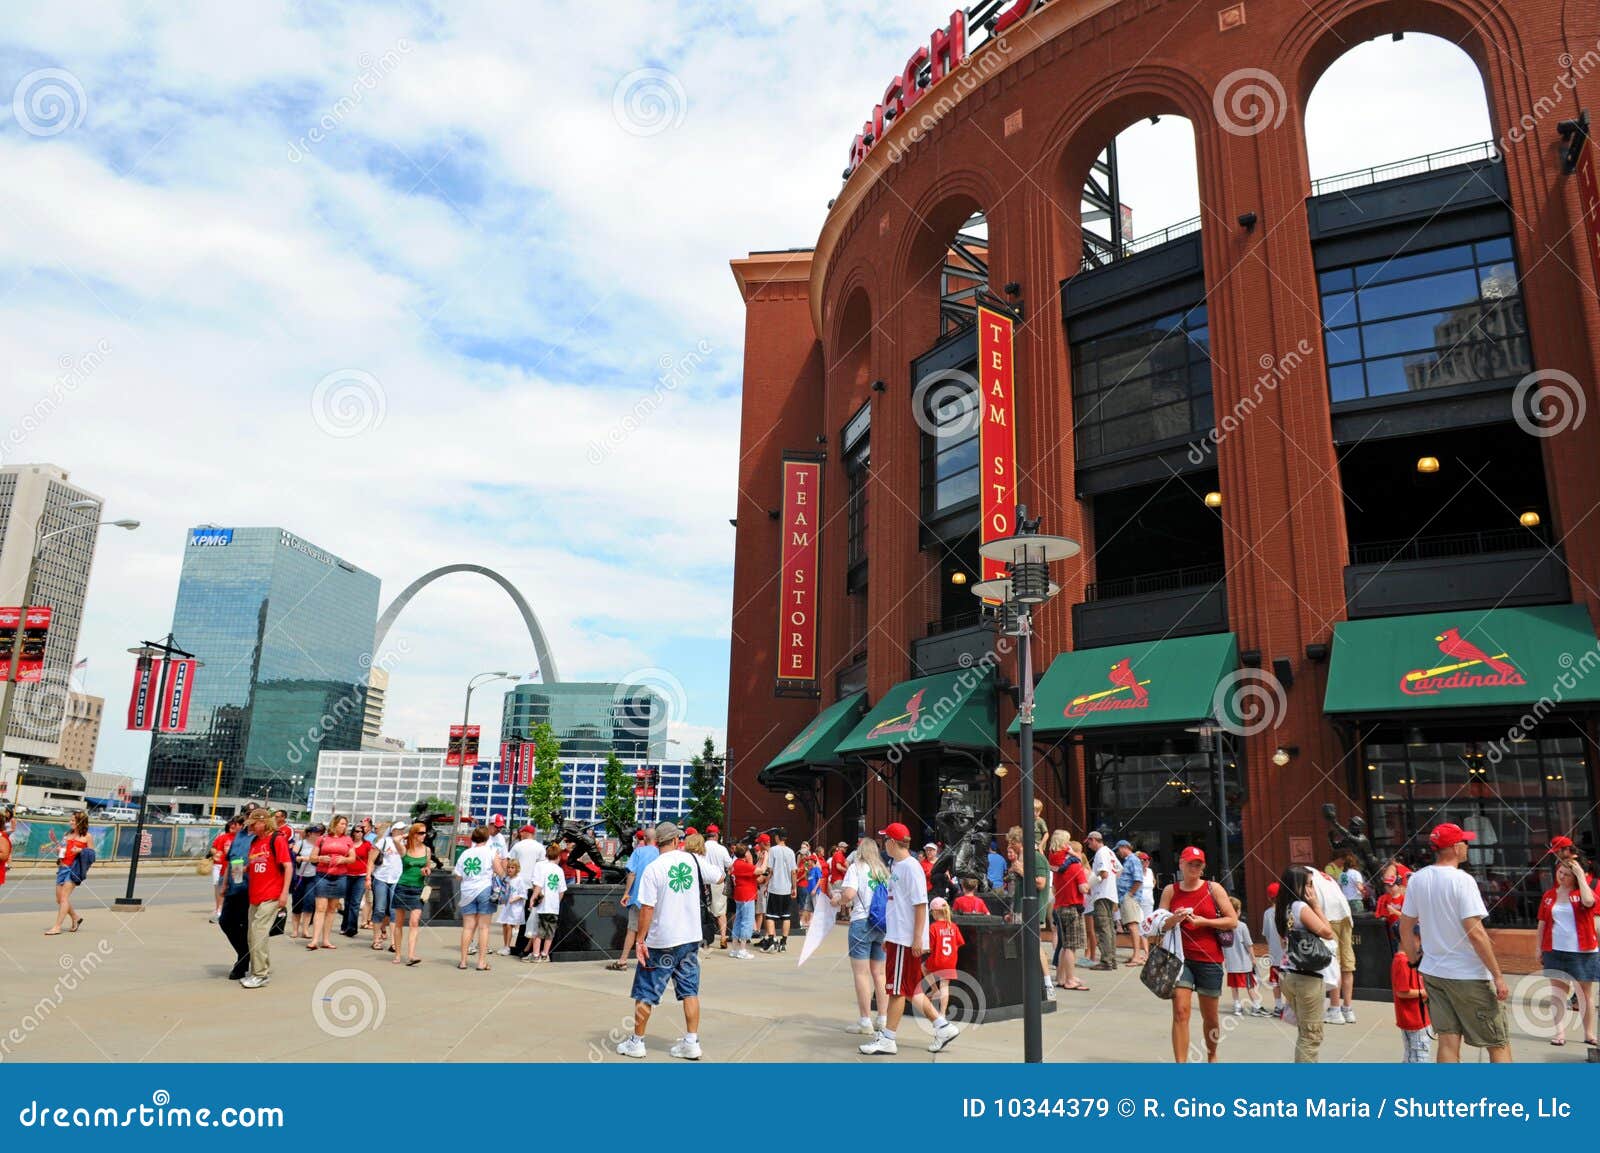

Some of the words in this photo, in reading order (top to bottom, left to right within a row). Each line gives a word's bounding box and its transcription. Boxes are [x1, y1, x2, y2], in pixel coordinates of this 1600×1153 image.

[990, 324, 1007, 427] TEAM
[792, 471, 808, 546] TEAM
[993, 457, 1008, 580] STO
[190, 535, 228, 546] KPMG
[790, 569, 806, 669] STORE
[1064, 695, 1149, 718] Cardinals
[1400, 669, 1527, 695] Cardinals
[942, 936, 952, 956] 5
